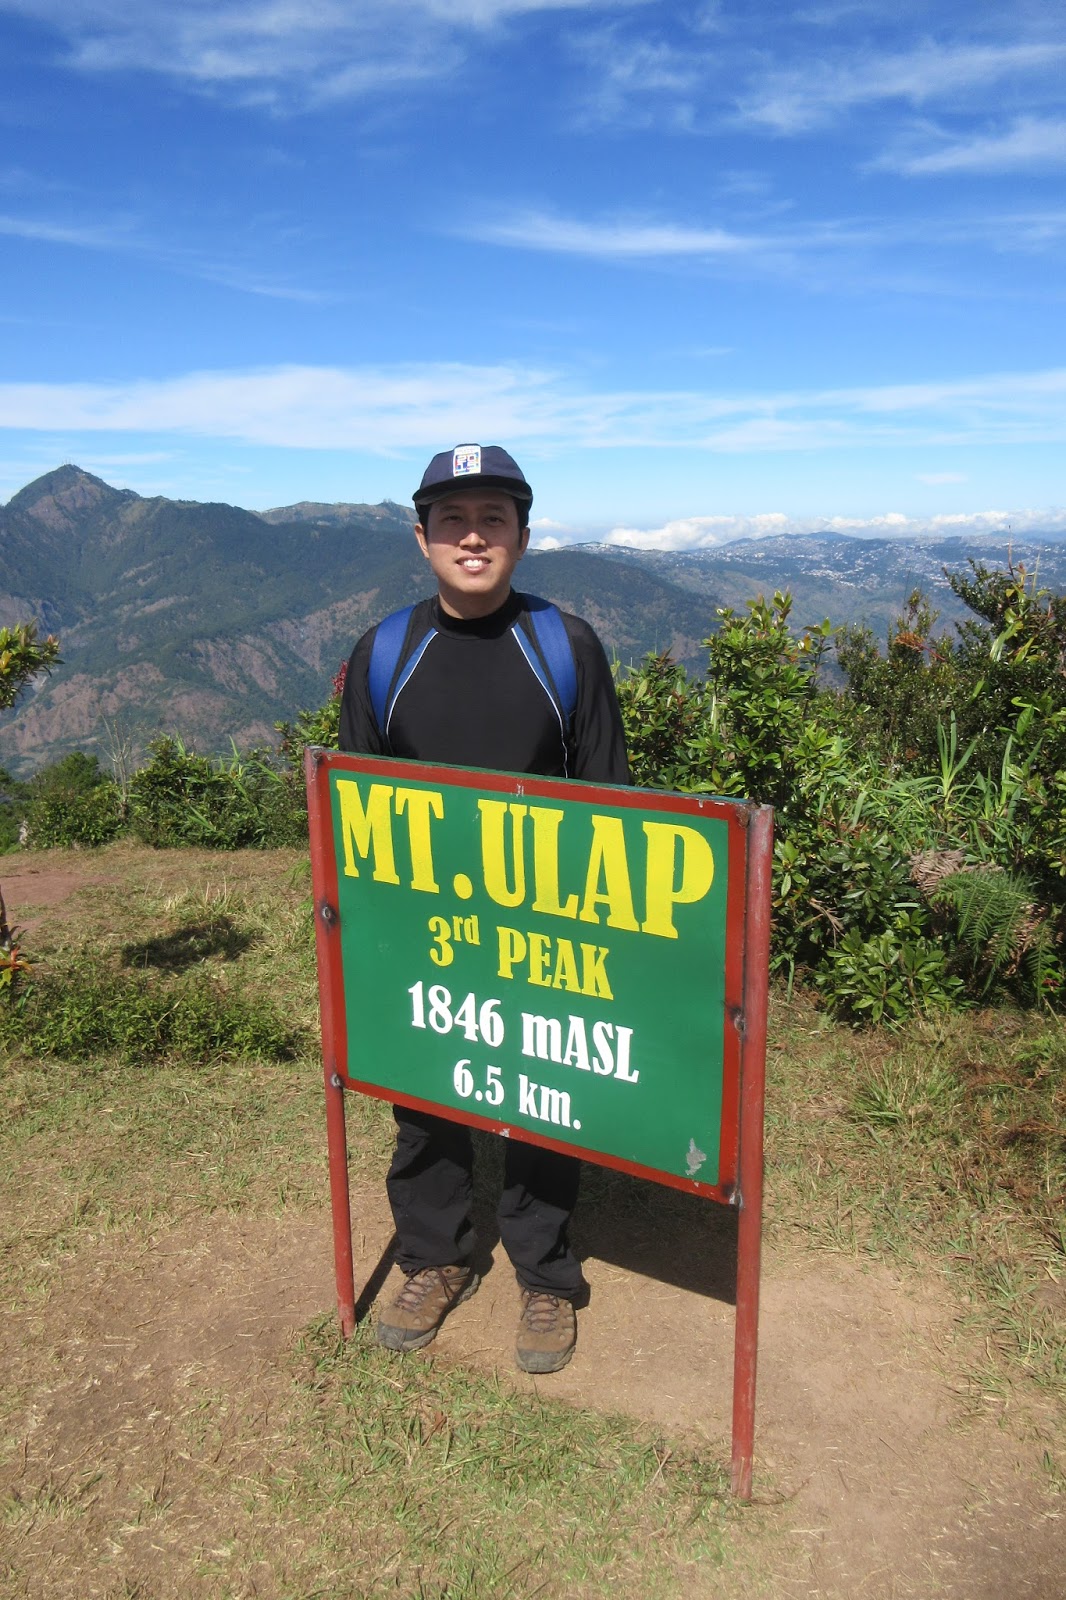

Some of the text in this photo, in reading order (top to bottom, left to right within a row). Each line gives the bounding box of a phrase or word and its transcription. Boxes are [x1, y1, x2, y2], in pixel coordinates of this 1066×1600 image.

[428, 914, 614, 1001] 3rd PEAK
[407, 980, 640, 1084] 1846 mASL
[453, 1058, 582, 1130] 6.5 km.
